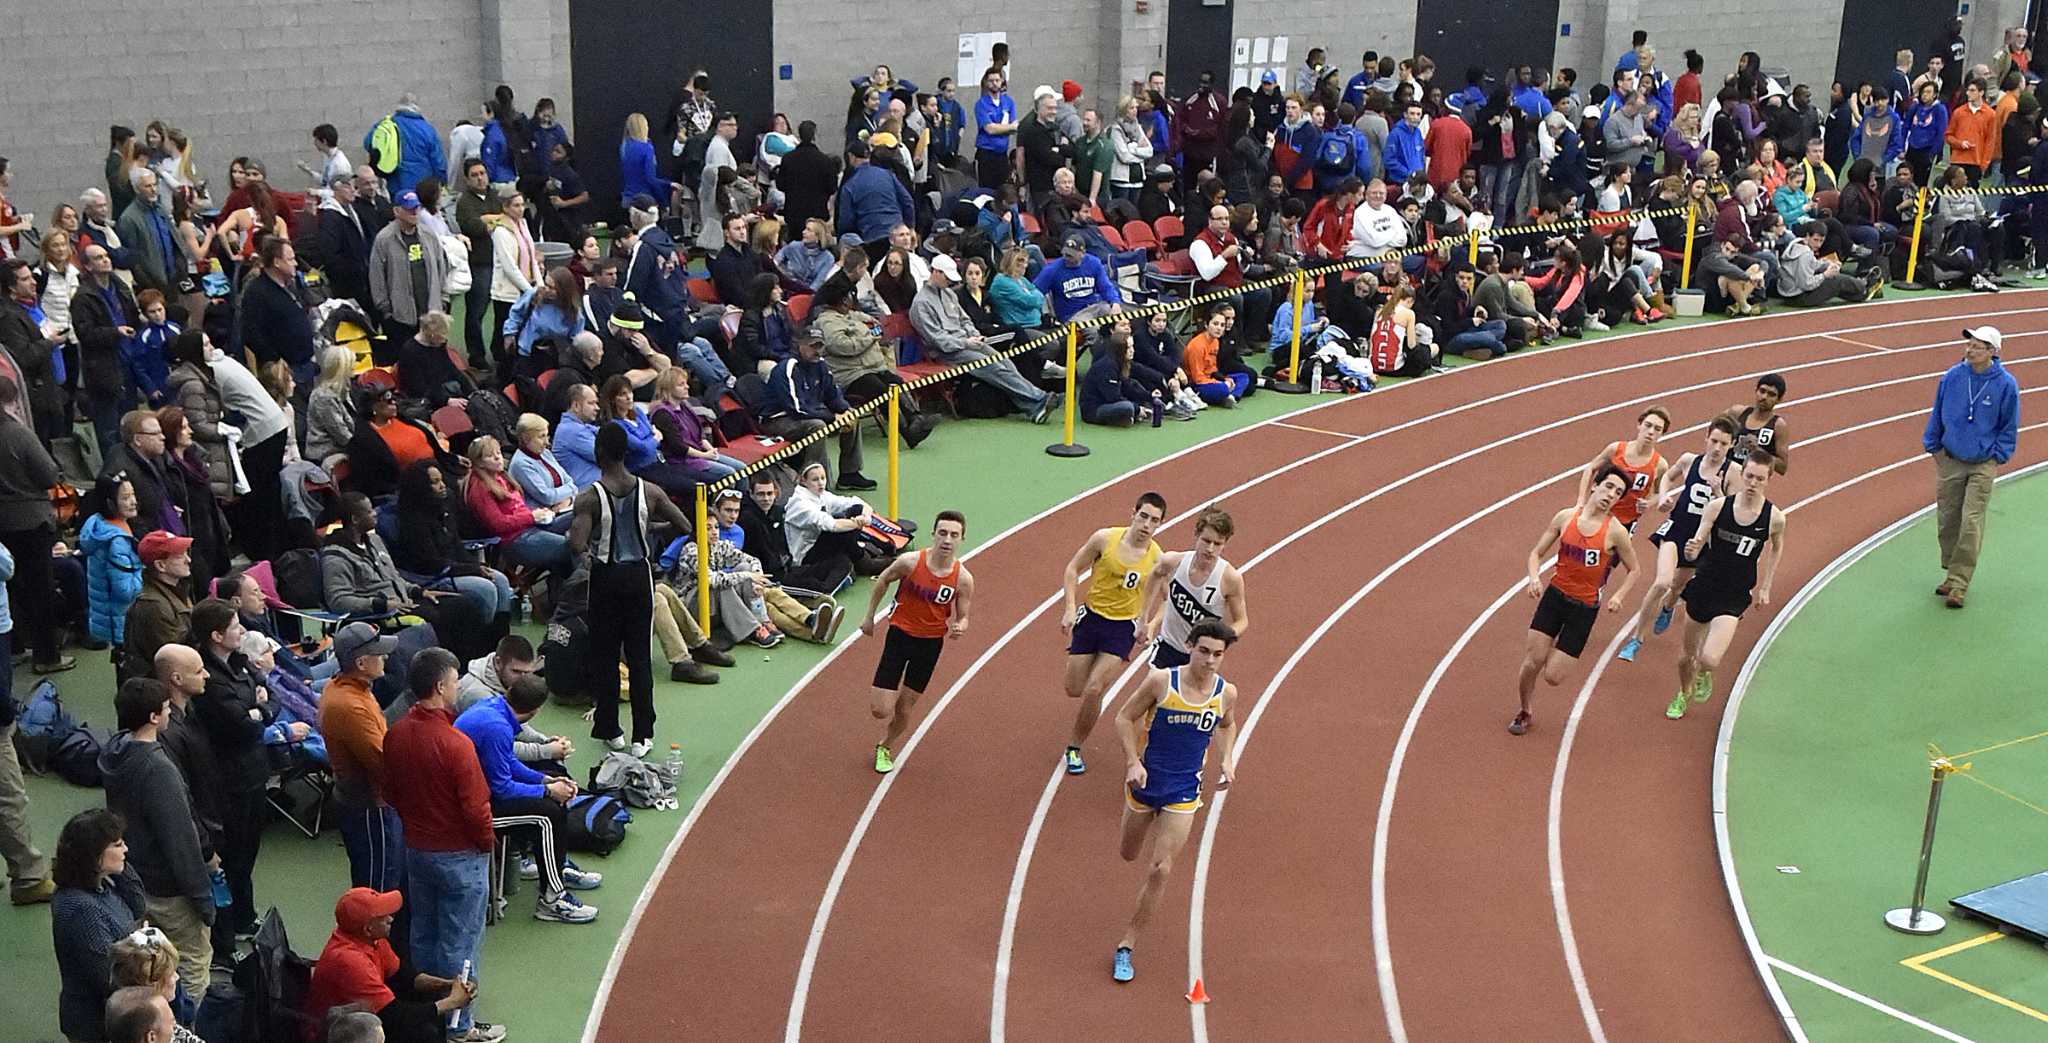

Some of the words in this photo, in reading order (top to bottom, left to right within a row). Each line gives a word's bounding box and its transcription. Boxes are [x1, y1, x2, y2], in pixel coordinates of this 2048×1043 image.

[1759, 429, 1770, 444] 5
[1635, 475, 1647, 489] 4
[1688, 482, 1713, 515] S
[1742, 539, 1752, 554] 1
[1587, 550, 1597, 566] 3
[1126, 572, 1138, 588] 8
[940, 587, 952, 603] 9
[1204, 586, 1216, 604] 7
[1167, 714, 1200, 726] COUGA
[1200, 710, 1214, 730] 6
